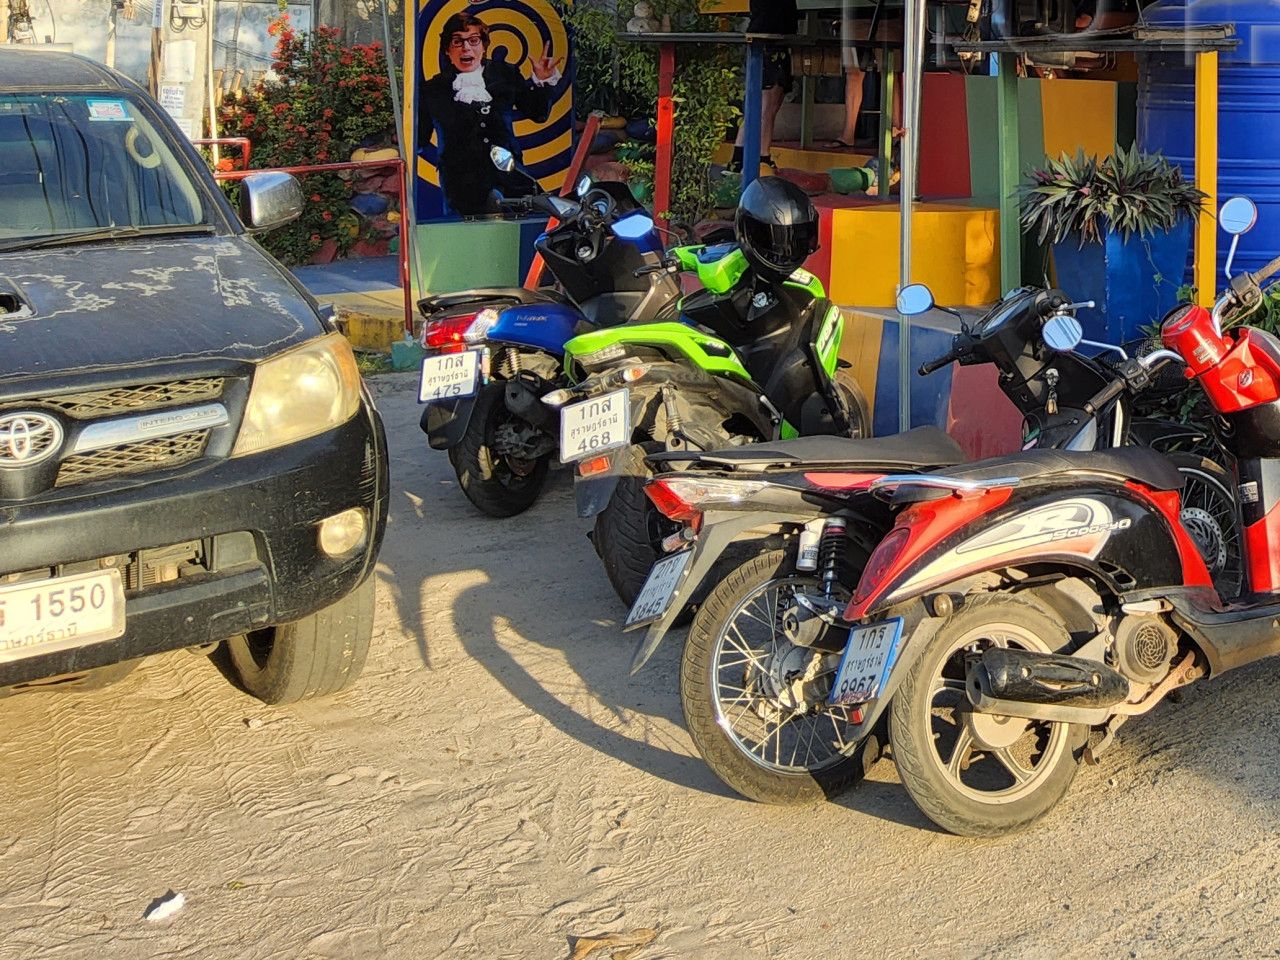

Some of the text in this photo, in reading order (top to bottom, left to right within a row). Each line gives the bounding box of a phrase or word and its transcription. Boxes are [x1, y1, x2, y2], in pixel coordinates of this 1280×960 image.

[432, 384, 461, 399] 475
[577, 431, 611, 453] 468
[30, 583, 106, 621] 1550
[840, 674, 877, 697] 9967
